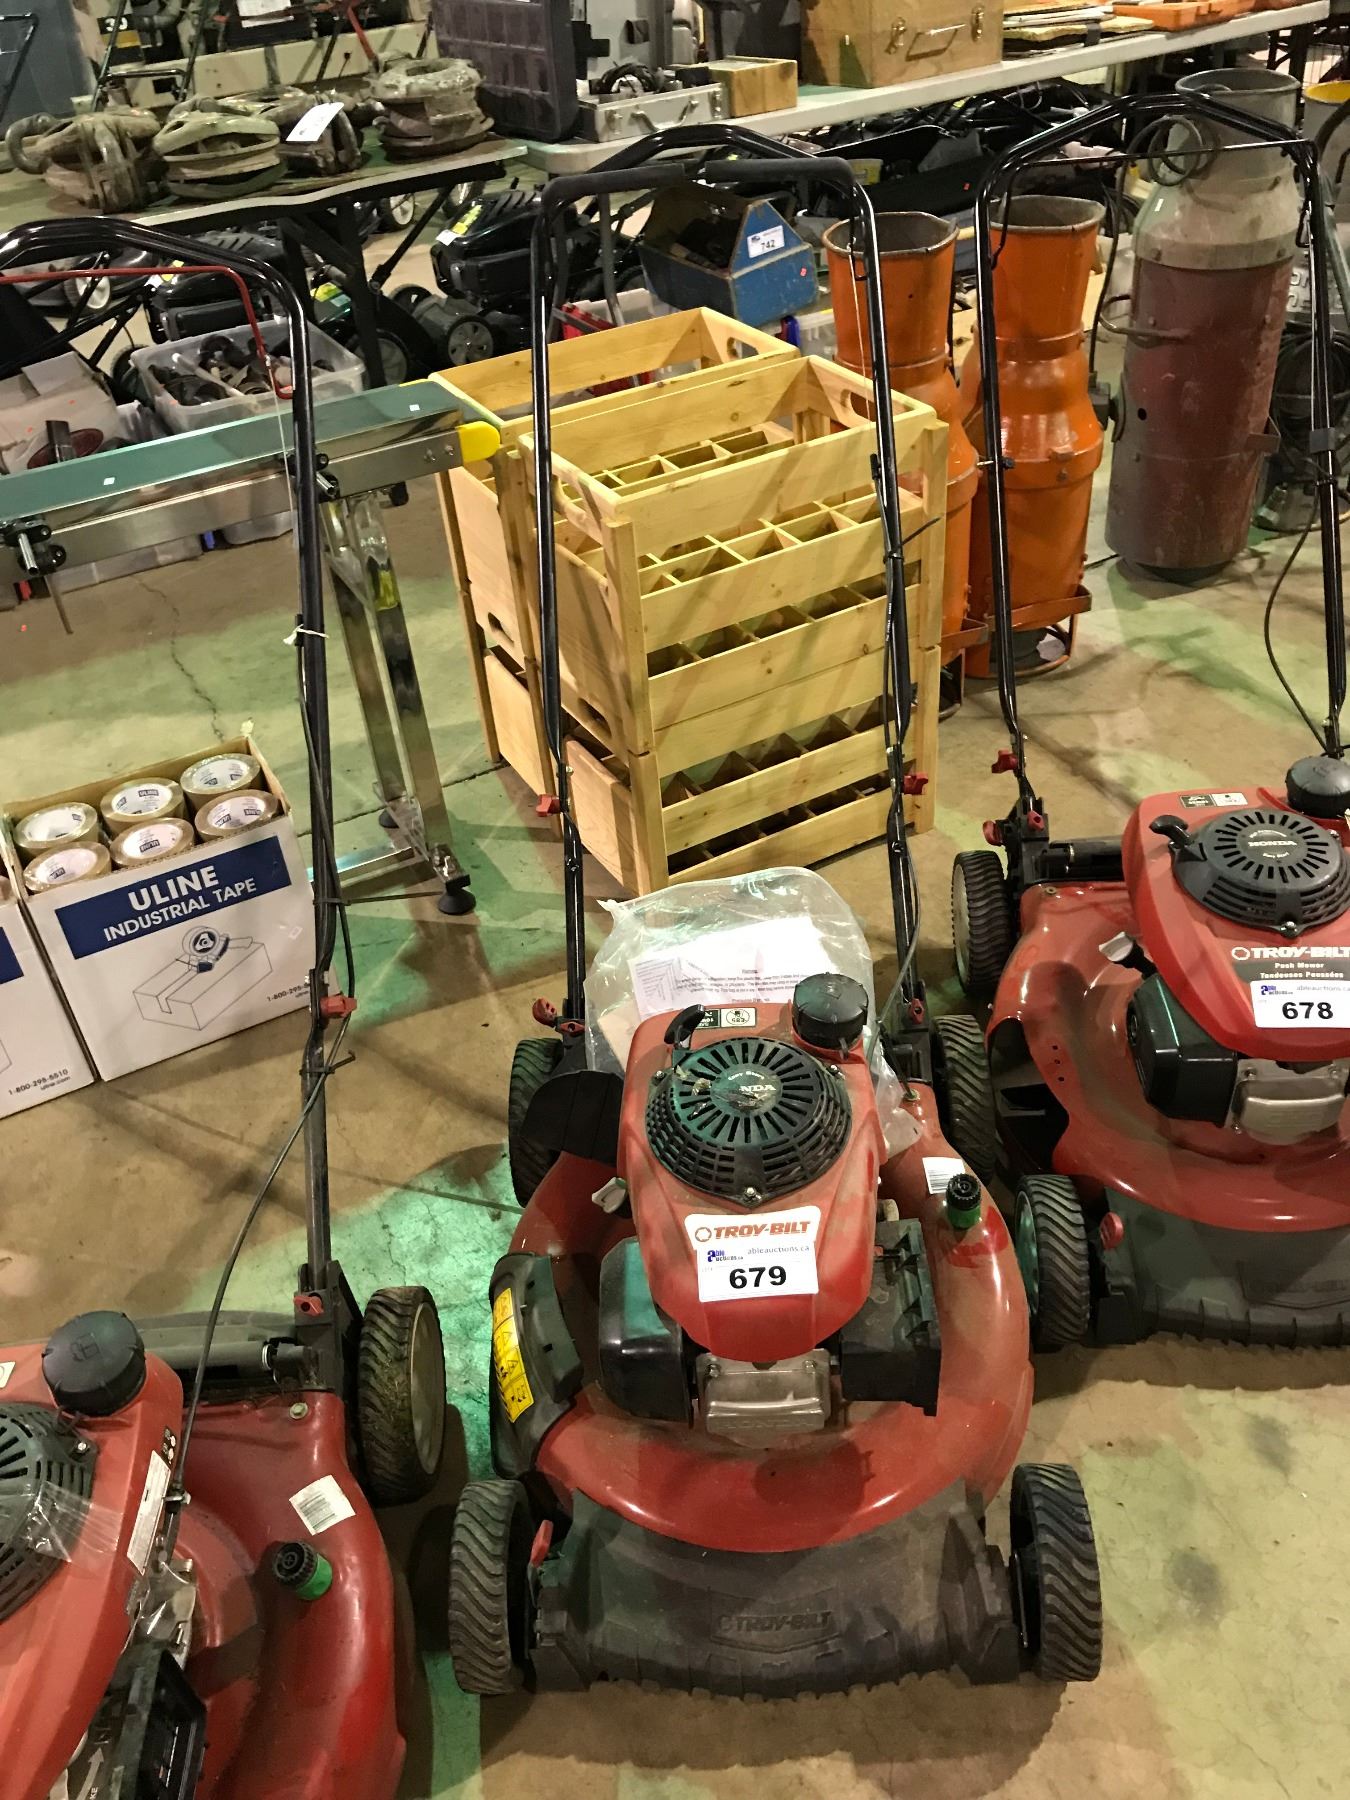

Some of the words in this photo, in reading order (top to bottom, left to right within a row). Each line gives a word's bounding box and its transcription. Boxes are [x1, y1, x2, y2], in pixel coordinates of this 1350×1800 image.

[760, 239, 776, 250] 742
[128, 865, 219, 911] ULINE
[103, 895, 210, 942] INDUSTRIAL
[212, 877, 257, 903] TAPE
[1251, 947, 1350, 958] TROY-BILT
[1282, 1002, 1333, 1019] 678
[714, 1221, 810, 1240] TROY-BILT
[729, 1266, 787, 1289] 679
